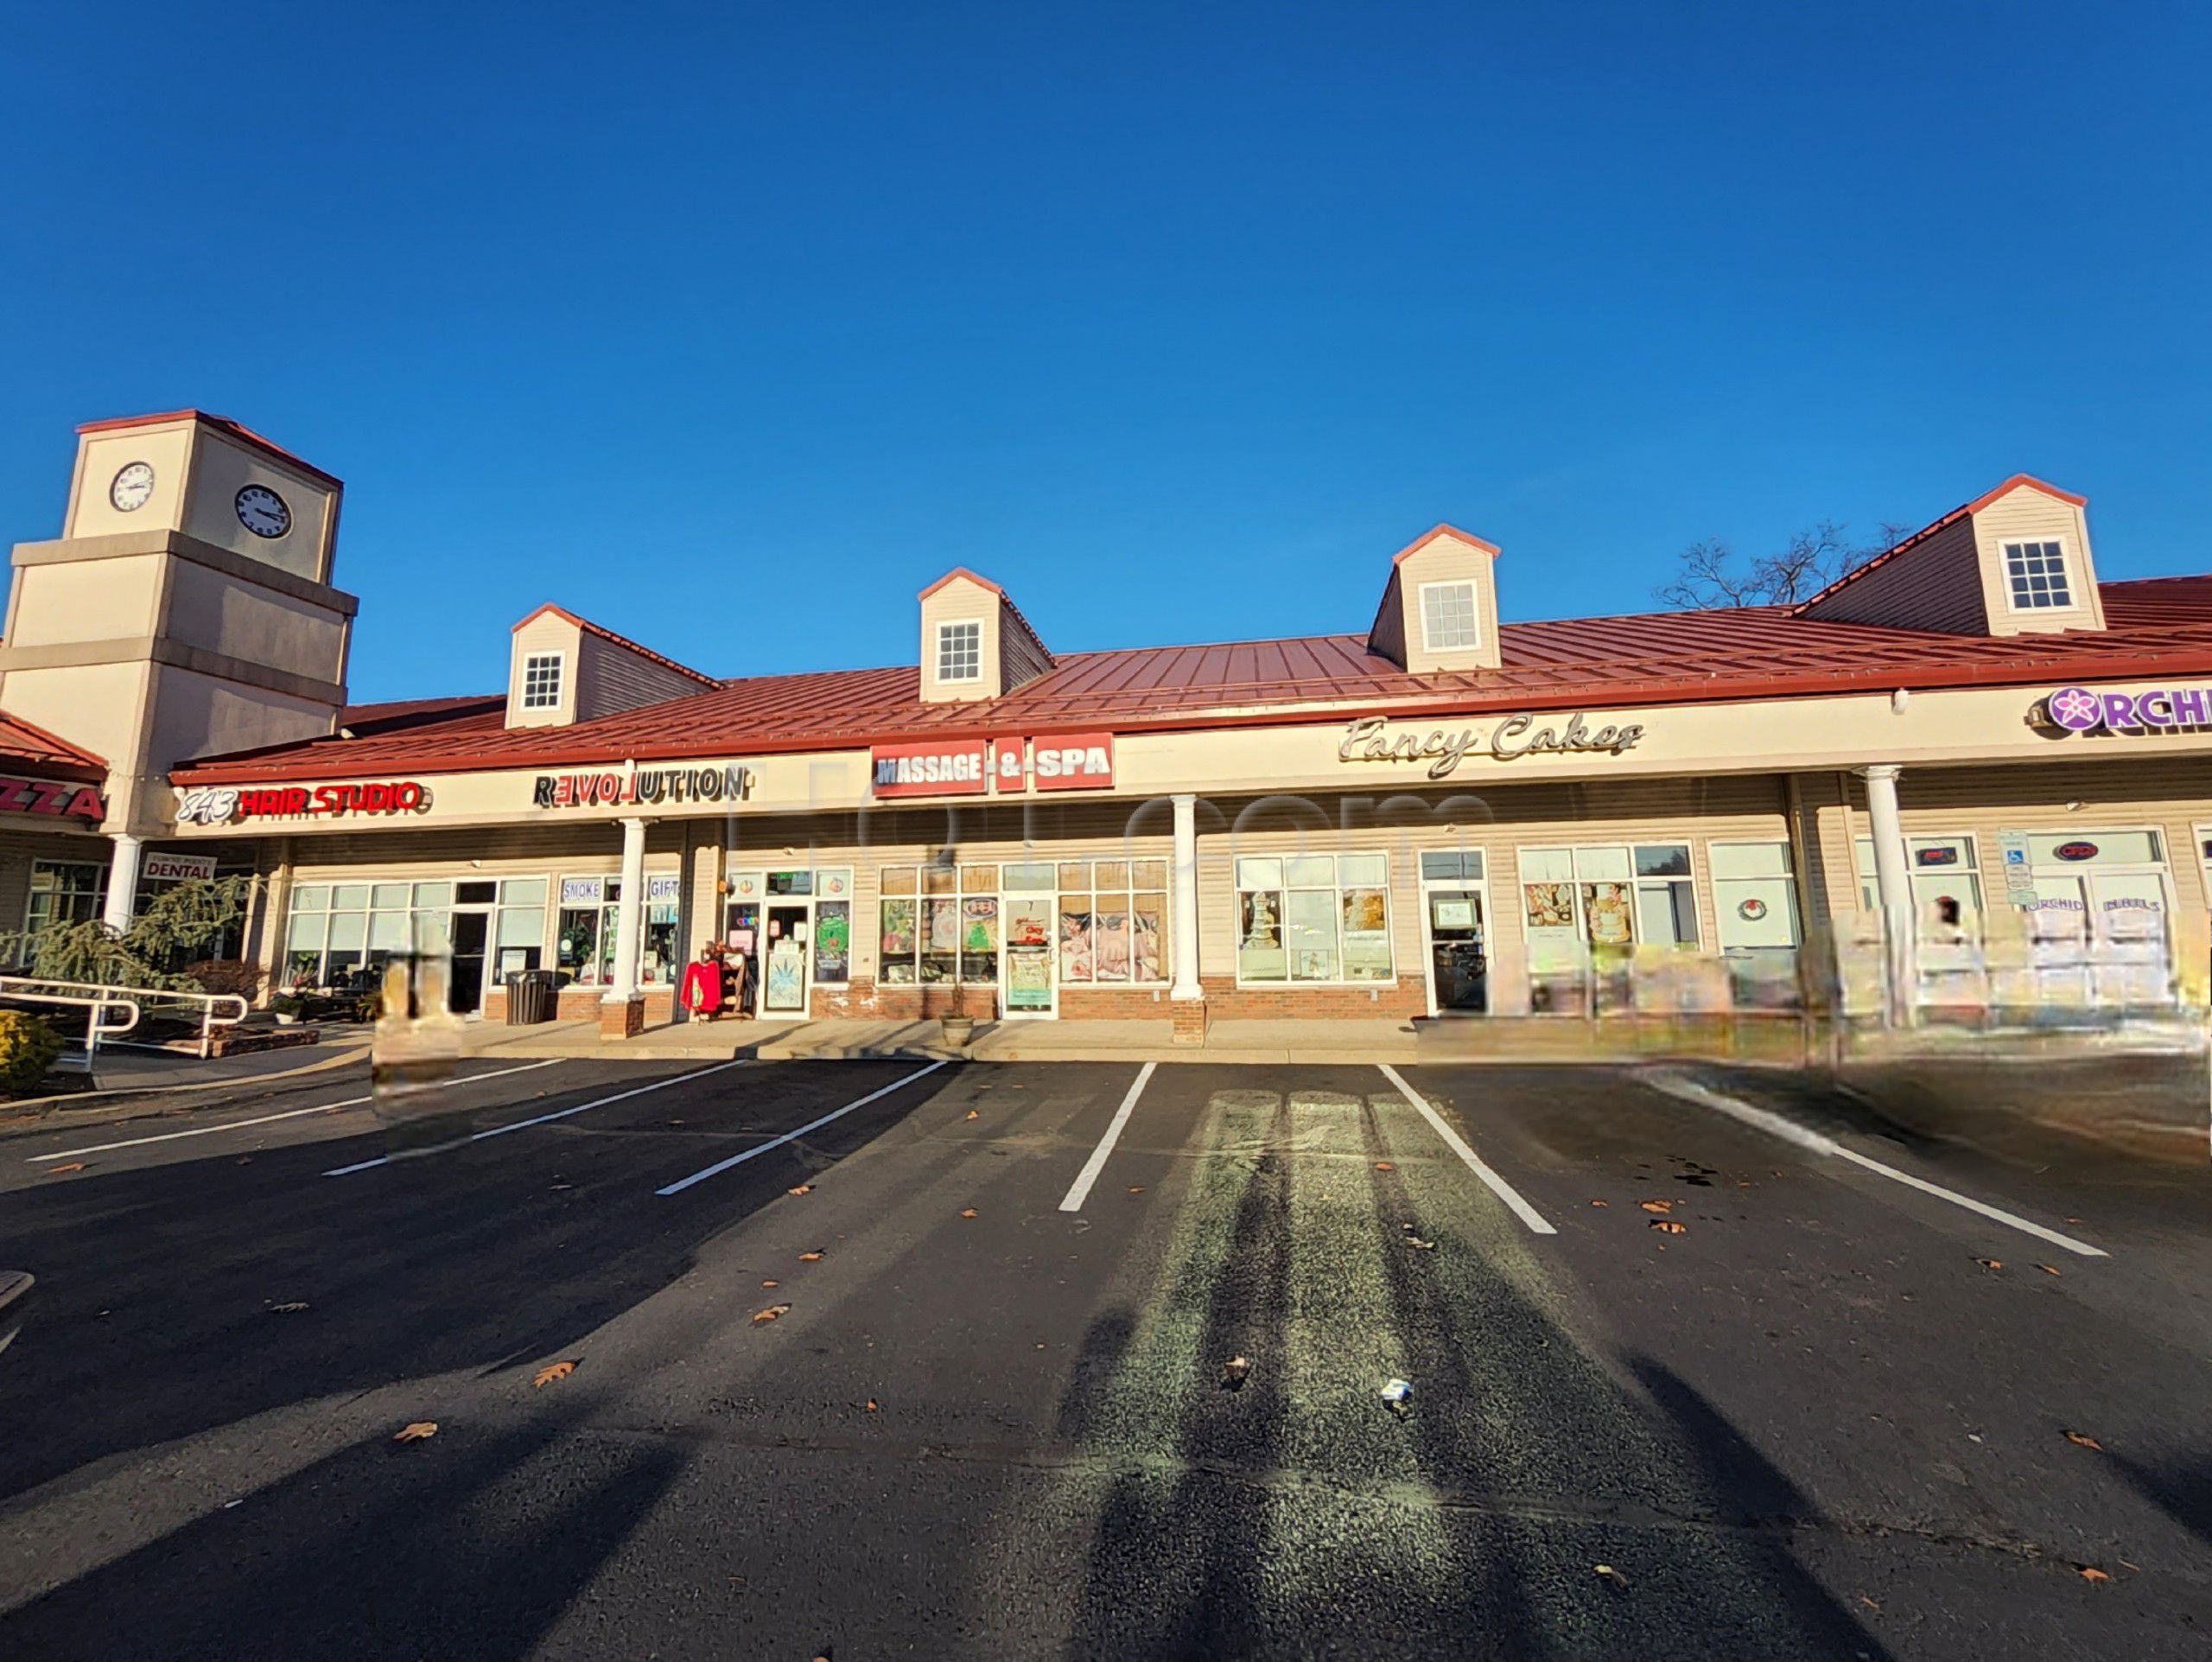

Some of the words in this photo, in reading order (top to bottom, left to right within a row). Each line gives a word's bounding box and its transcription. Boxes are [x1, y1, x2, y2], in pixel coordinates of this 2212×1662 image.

[1339, 715, 1477, 780] Fancy
[1491, 712, 1645, 757] Cakes
[876, 753, 982, 785] MASSAGE
[1001, 752, 1021, 778] &
[1036, 747, 1111, 777] SPA
[175, 787, 236, 822] 843
[239, 787, 307, 816] HAIR
[312, 780, 420, 813] STUDIO
[533, 766, 746, 806] REVOLUTION
[147, 863, 210, 879] DENTAL
[563, 882, 599, 898] SMOKE
